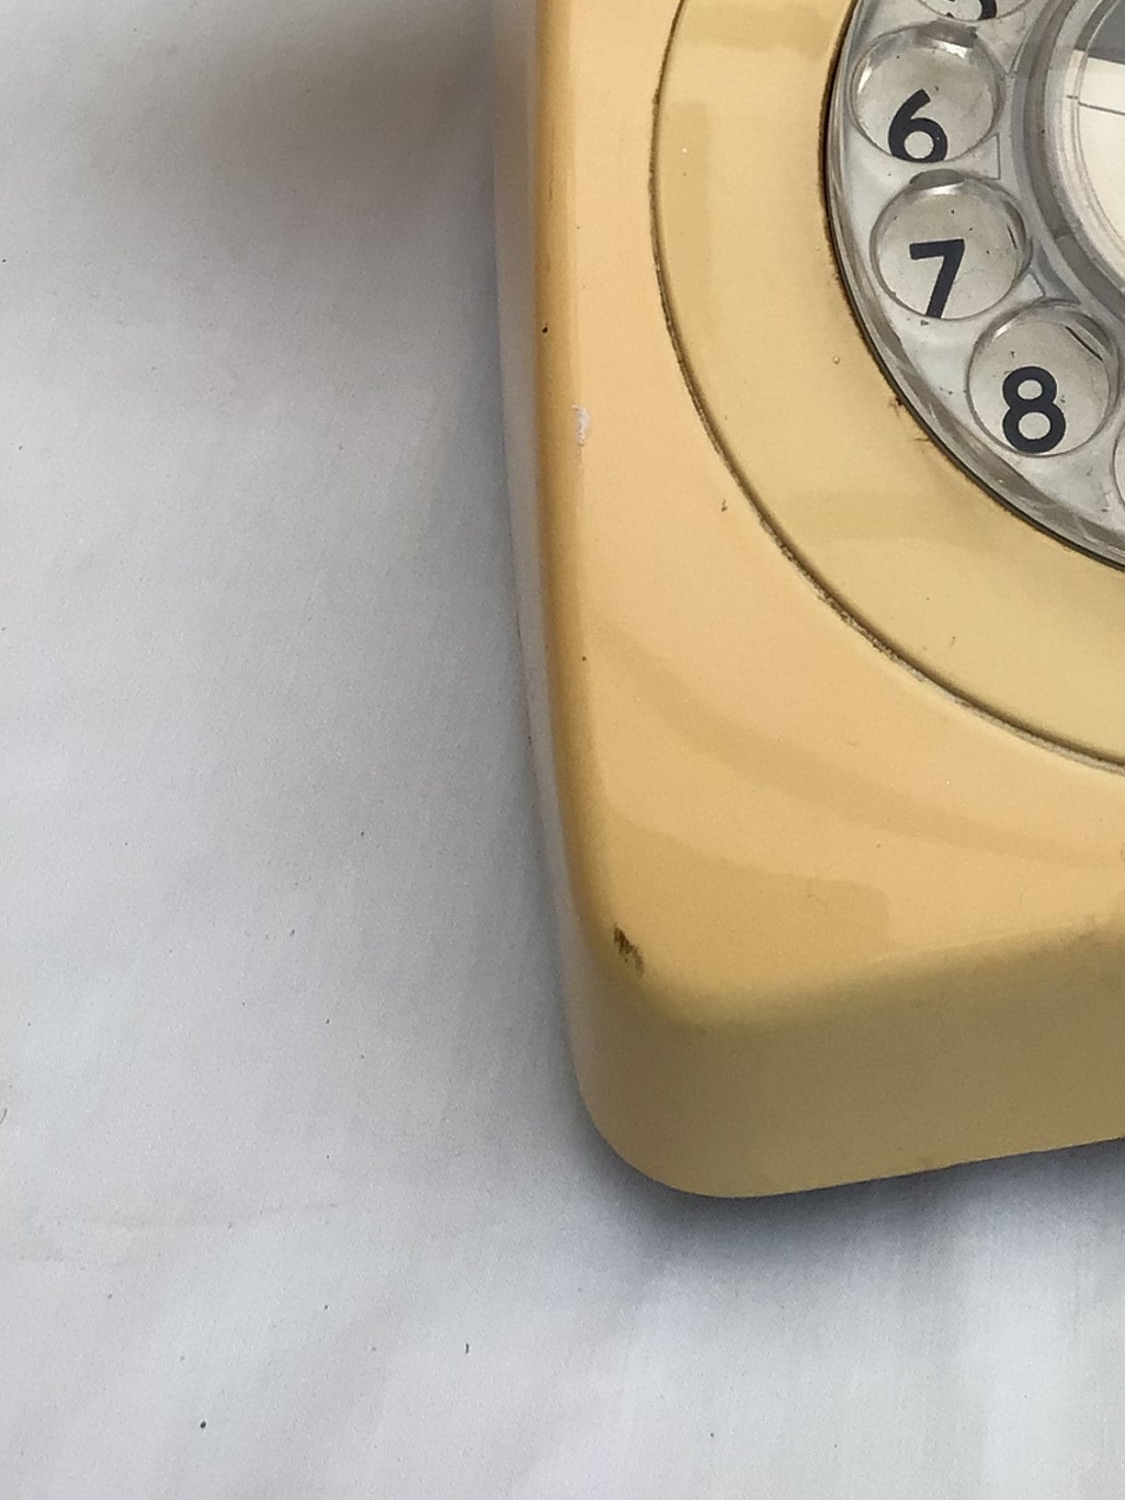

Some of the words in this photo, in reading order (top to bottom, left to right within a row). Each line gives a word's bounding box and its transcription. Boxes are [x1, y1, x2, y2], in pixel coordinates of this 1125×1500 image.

[887, 89, 949, 164] 6
[909, 238, 967, 319] 7
[1000, 366, 1066, 454] 8
